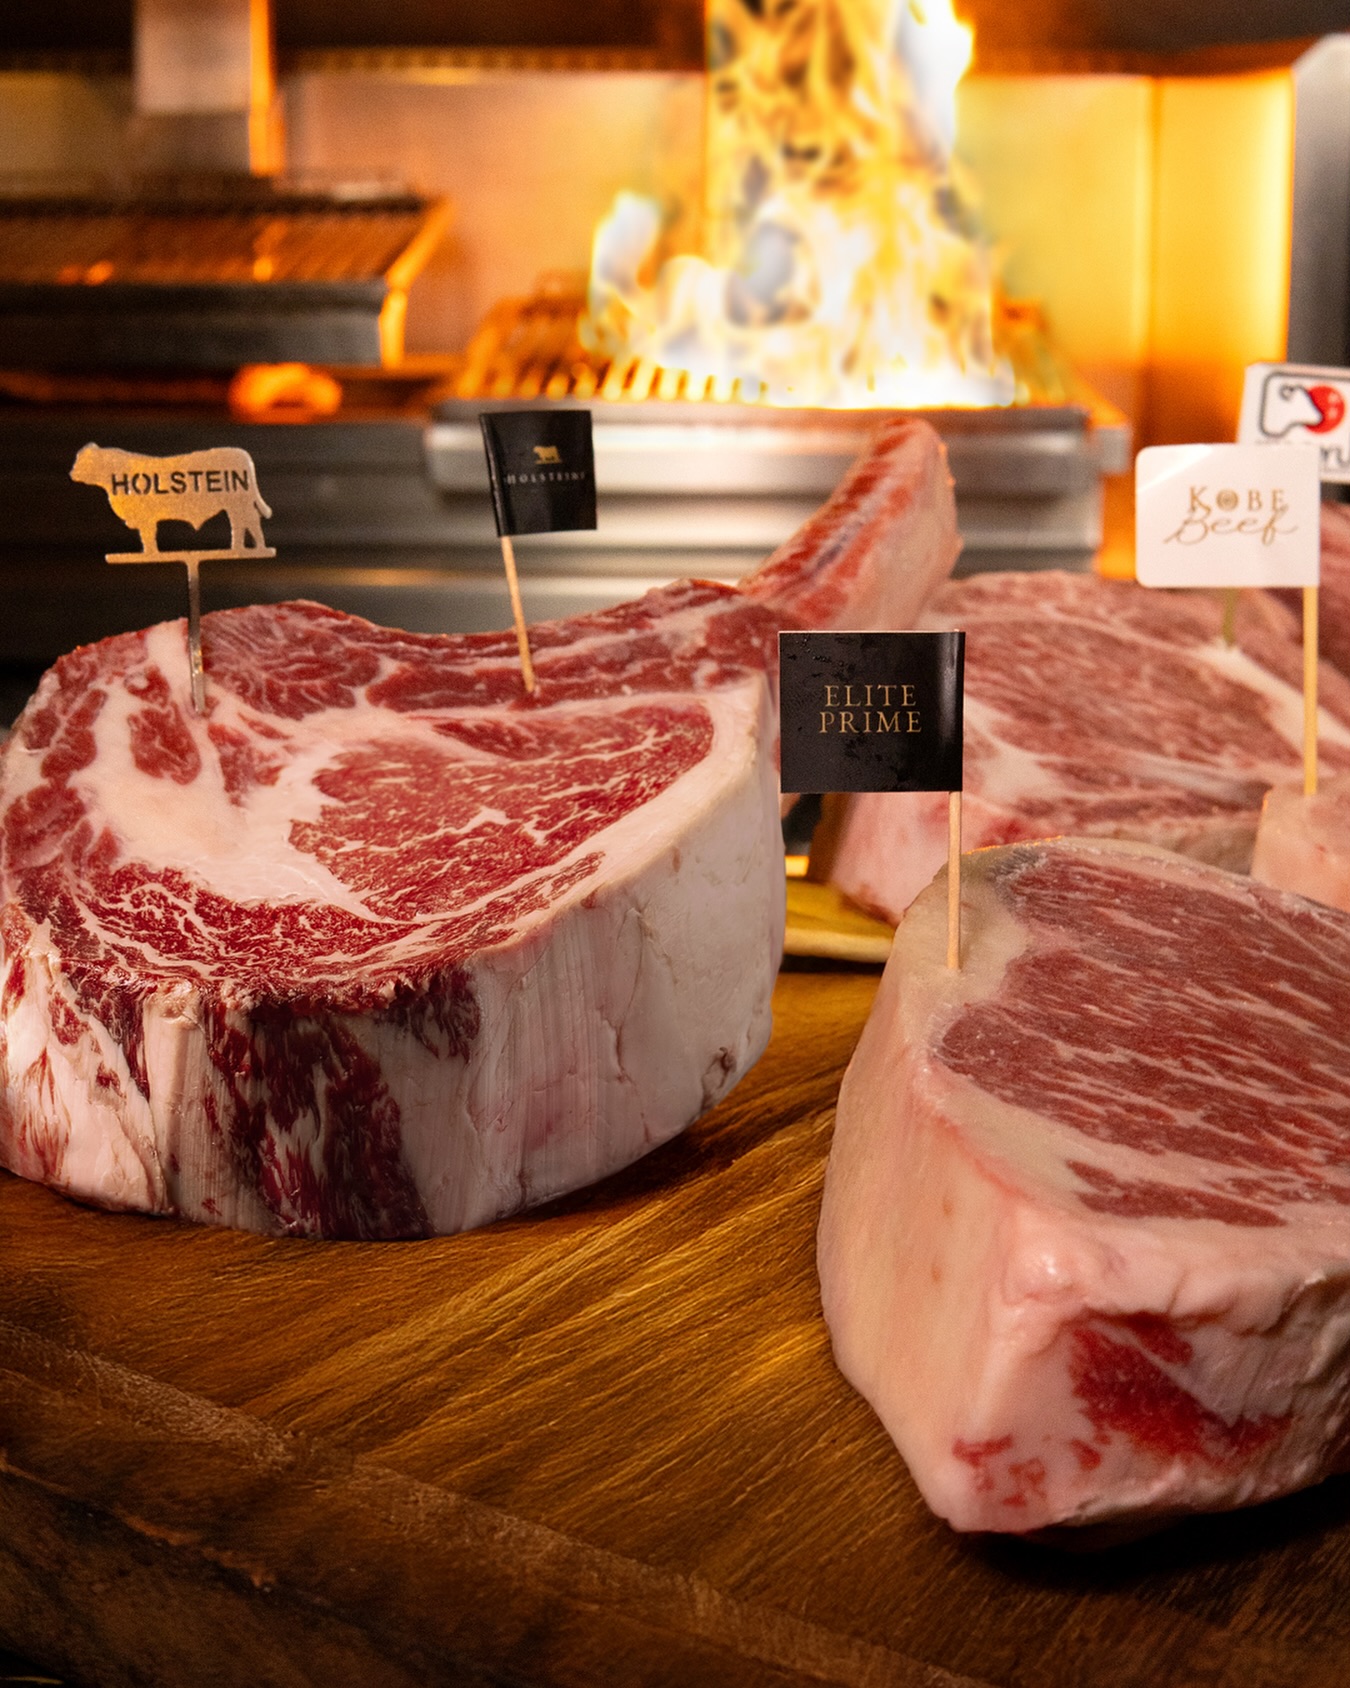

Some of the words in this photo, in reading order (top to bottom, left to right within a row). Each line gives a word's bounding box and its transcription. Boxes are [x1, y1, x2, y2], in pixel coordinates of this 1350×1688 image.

[111, 470, 249, 495] HOLSTEIN
[1189, 486, 1285, 512] KOBE
[1163, 504, 1299, 546] Beef
[824, 684, 917, 707] ELITE
[819, 711, 922, 733] PRIME
